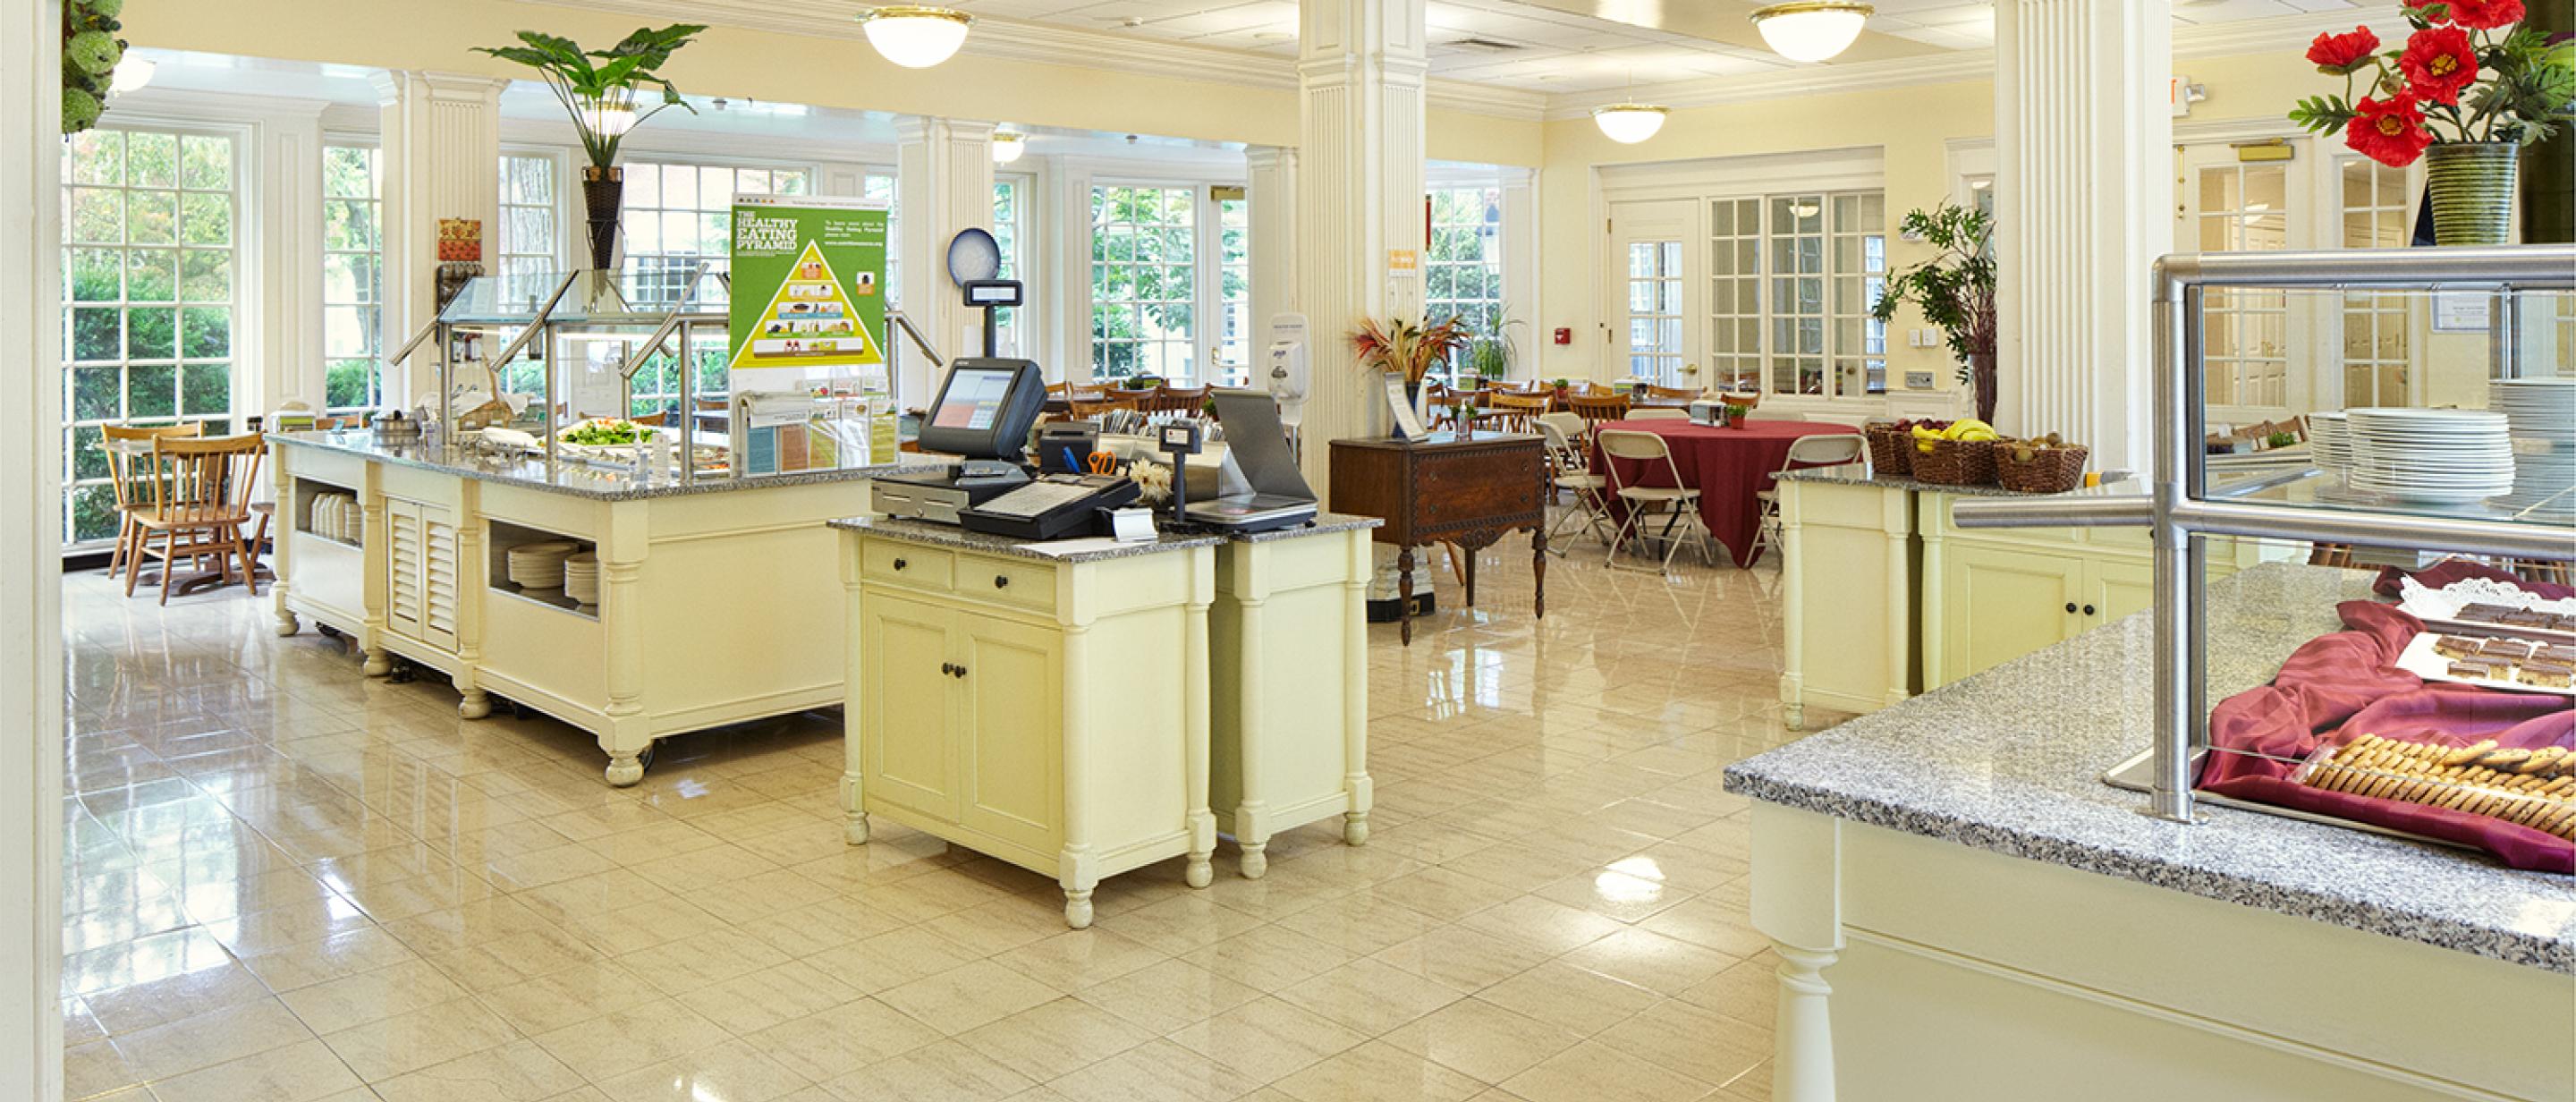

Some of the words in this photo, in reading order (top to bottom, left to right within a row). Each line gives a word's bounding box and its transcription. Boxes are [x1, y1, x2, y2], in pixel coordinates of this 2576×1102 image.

[737, 217, 798, 228] HEALTHY
[737, 227, 797, 240] EATING
[737, 240, 797, 250] PYRAMID
